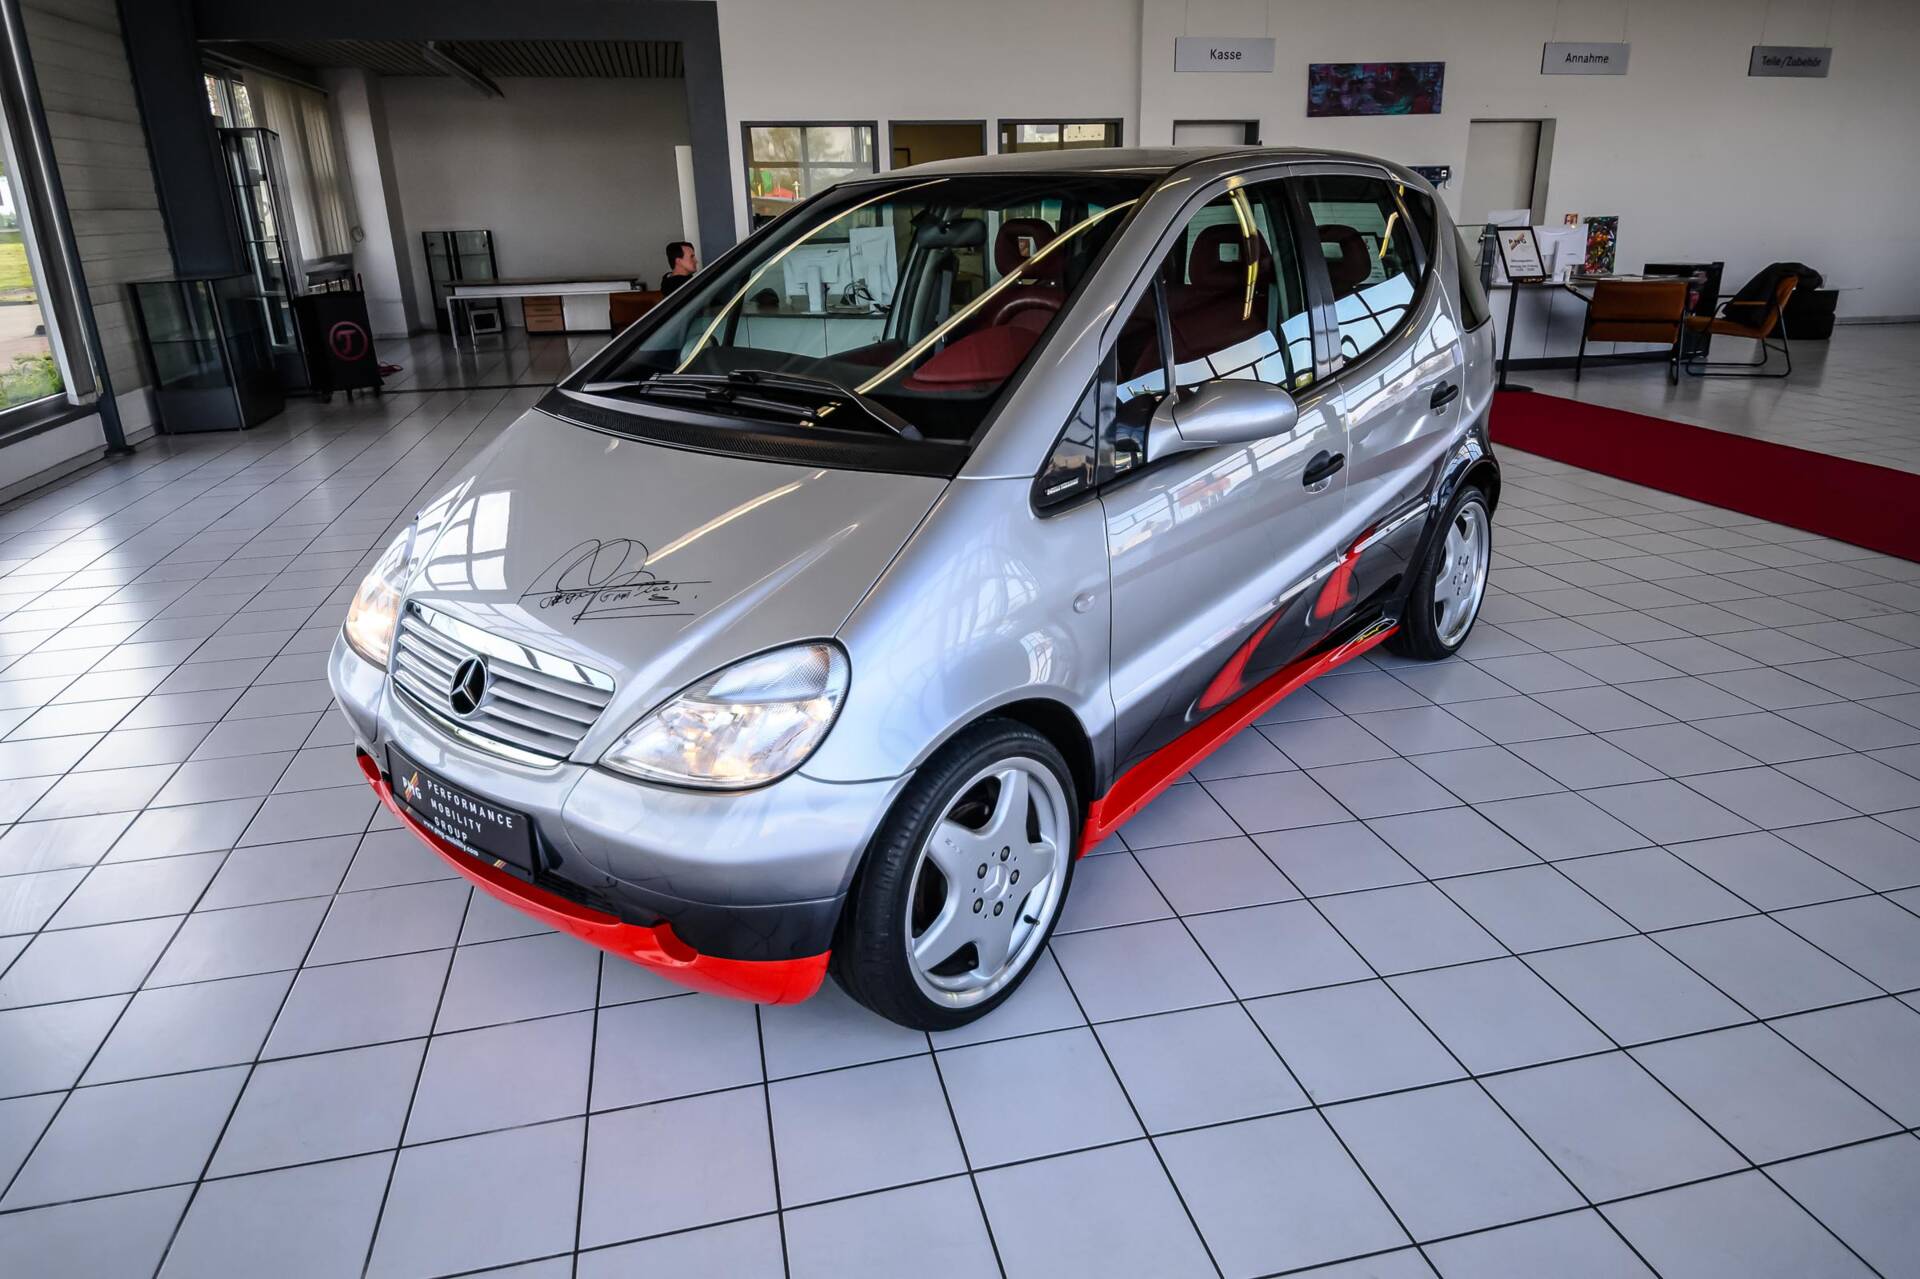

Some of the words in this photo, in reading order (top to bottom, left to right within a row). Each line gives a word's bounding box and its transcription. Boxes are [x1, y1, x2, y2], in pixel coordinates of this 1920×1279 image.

[1210, 48, 1242, 60] Kasse
[1565, 53, 1609, 64] Annahme
[427, 780, 513, 829] PERFORMANCE
[430, 798, 482, 833] MOBILITY
[434, 816, 468, 842] GROUP
